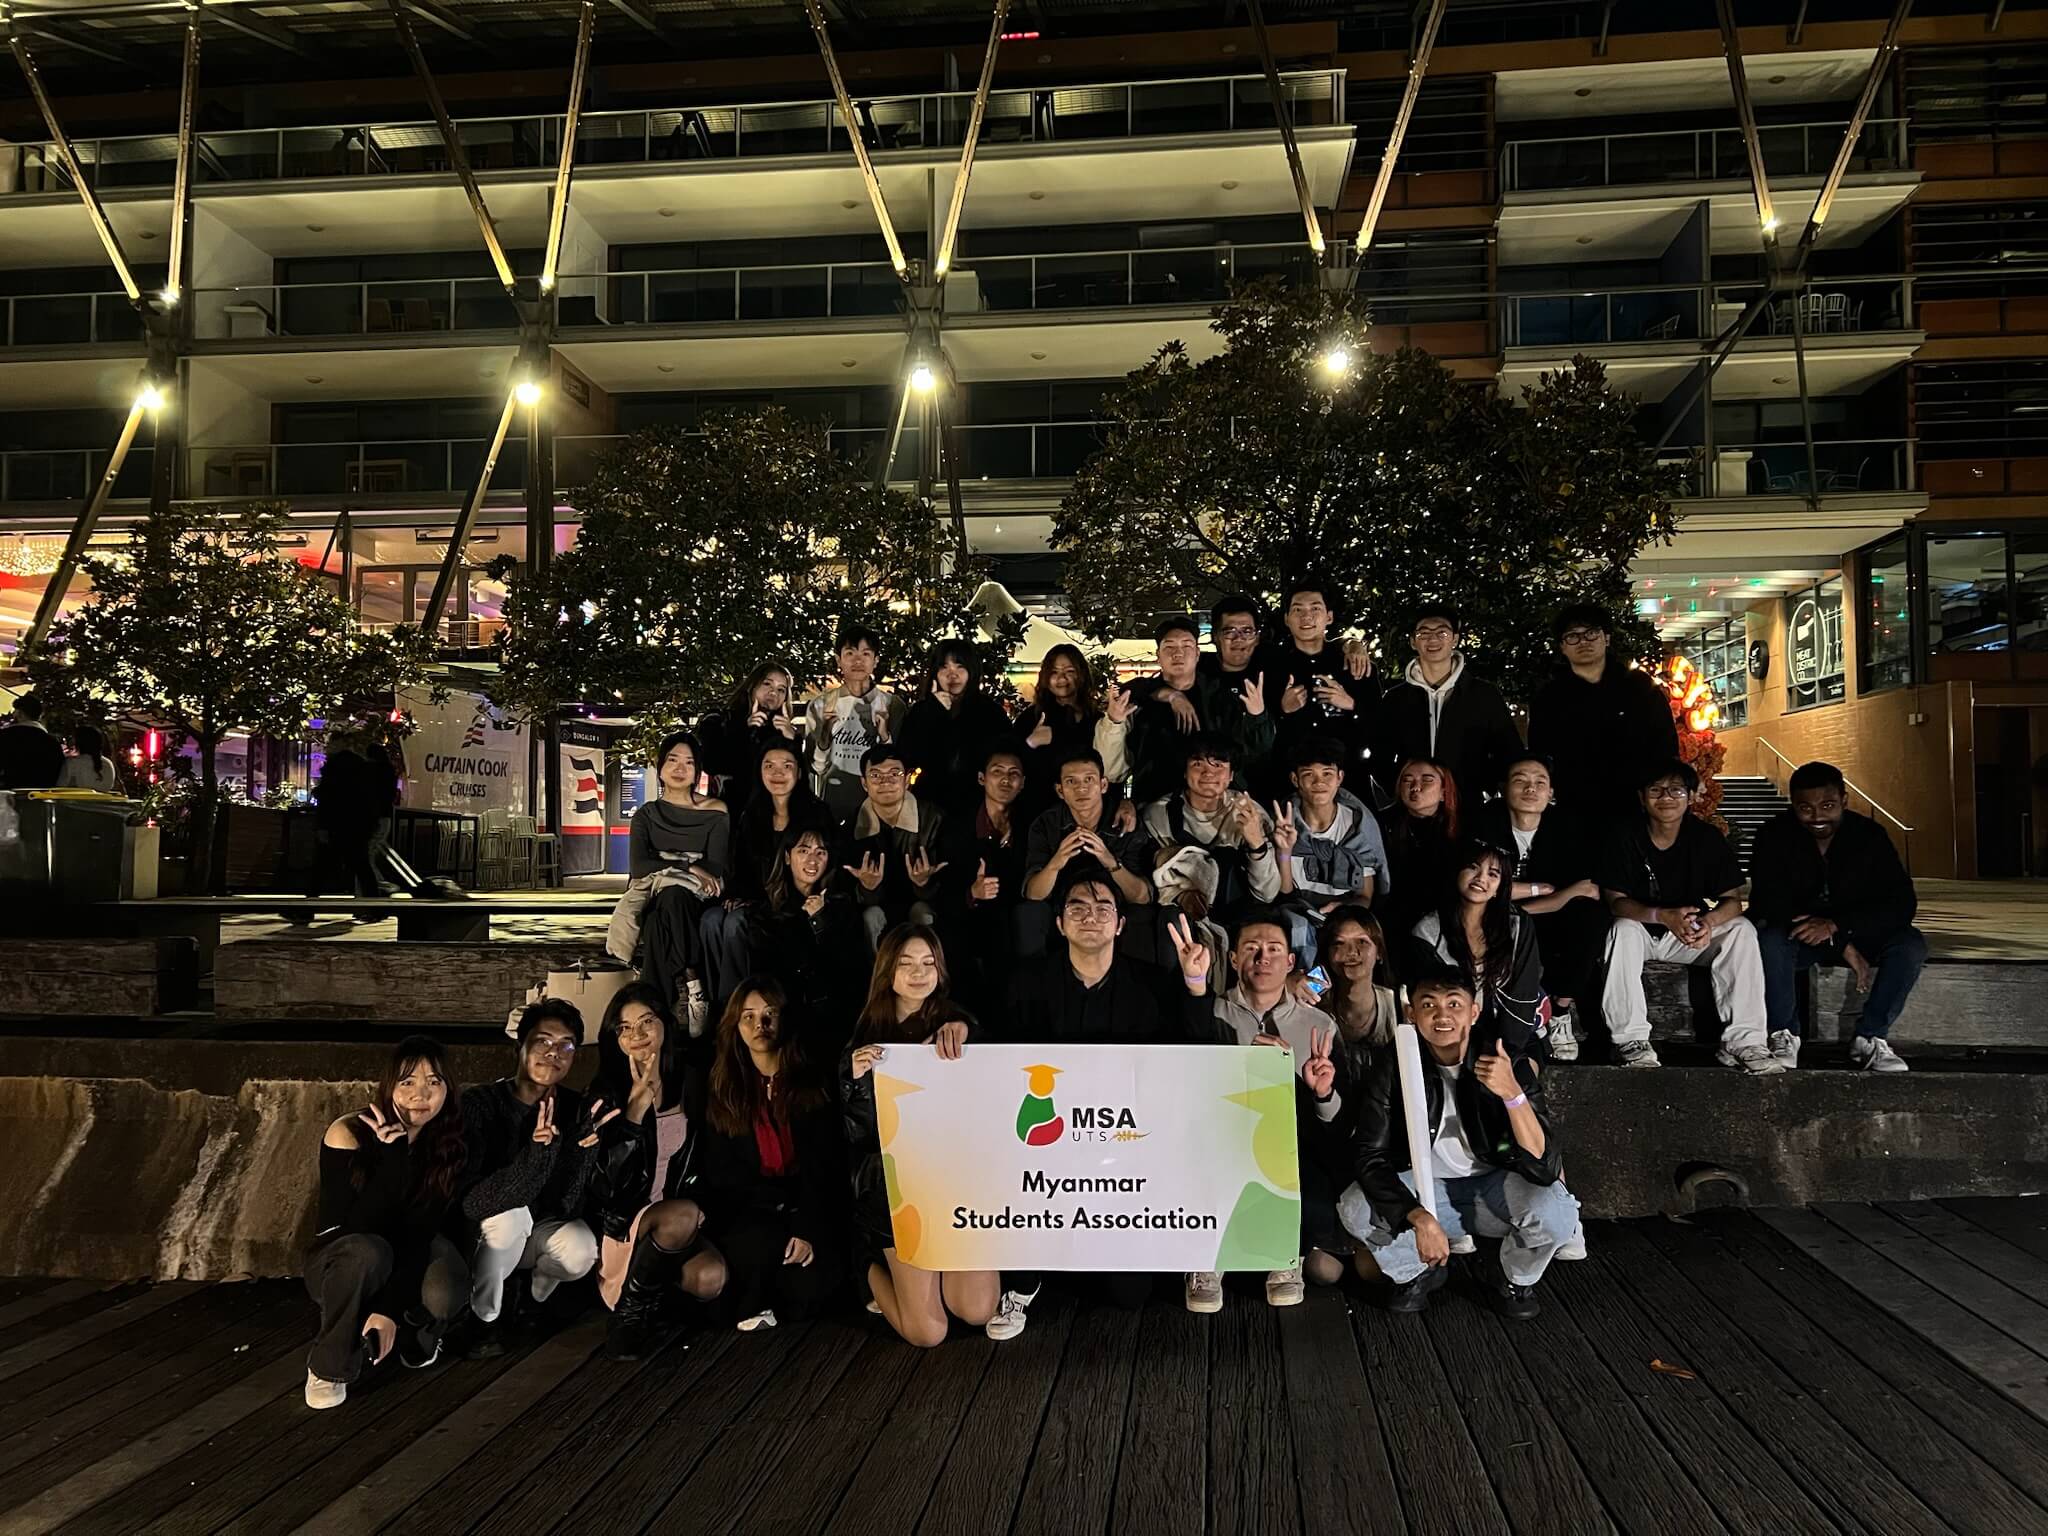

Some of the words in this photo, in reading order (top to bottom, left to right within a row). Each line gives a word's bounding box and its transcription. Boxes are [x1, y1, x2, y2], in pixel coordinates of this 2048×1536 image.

[425, 753, 476, 775] CAPTAIN
[478, 758, 508, 777] COOK
[449, 781, 487, 798] CRUISES
[1073, 1108, 1136, 1128] MSA
[1073, 1131, 1106, 1141] UTS
[1023, 1171, 1146, 1199] Myanmar
[953, 1206, 1063, 1228] Students
[1071, 1207, 1216, 1229] Association
